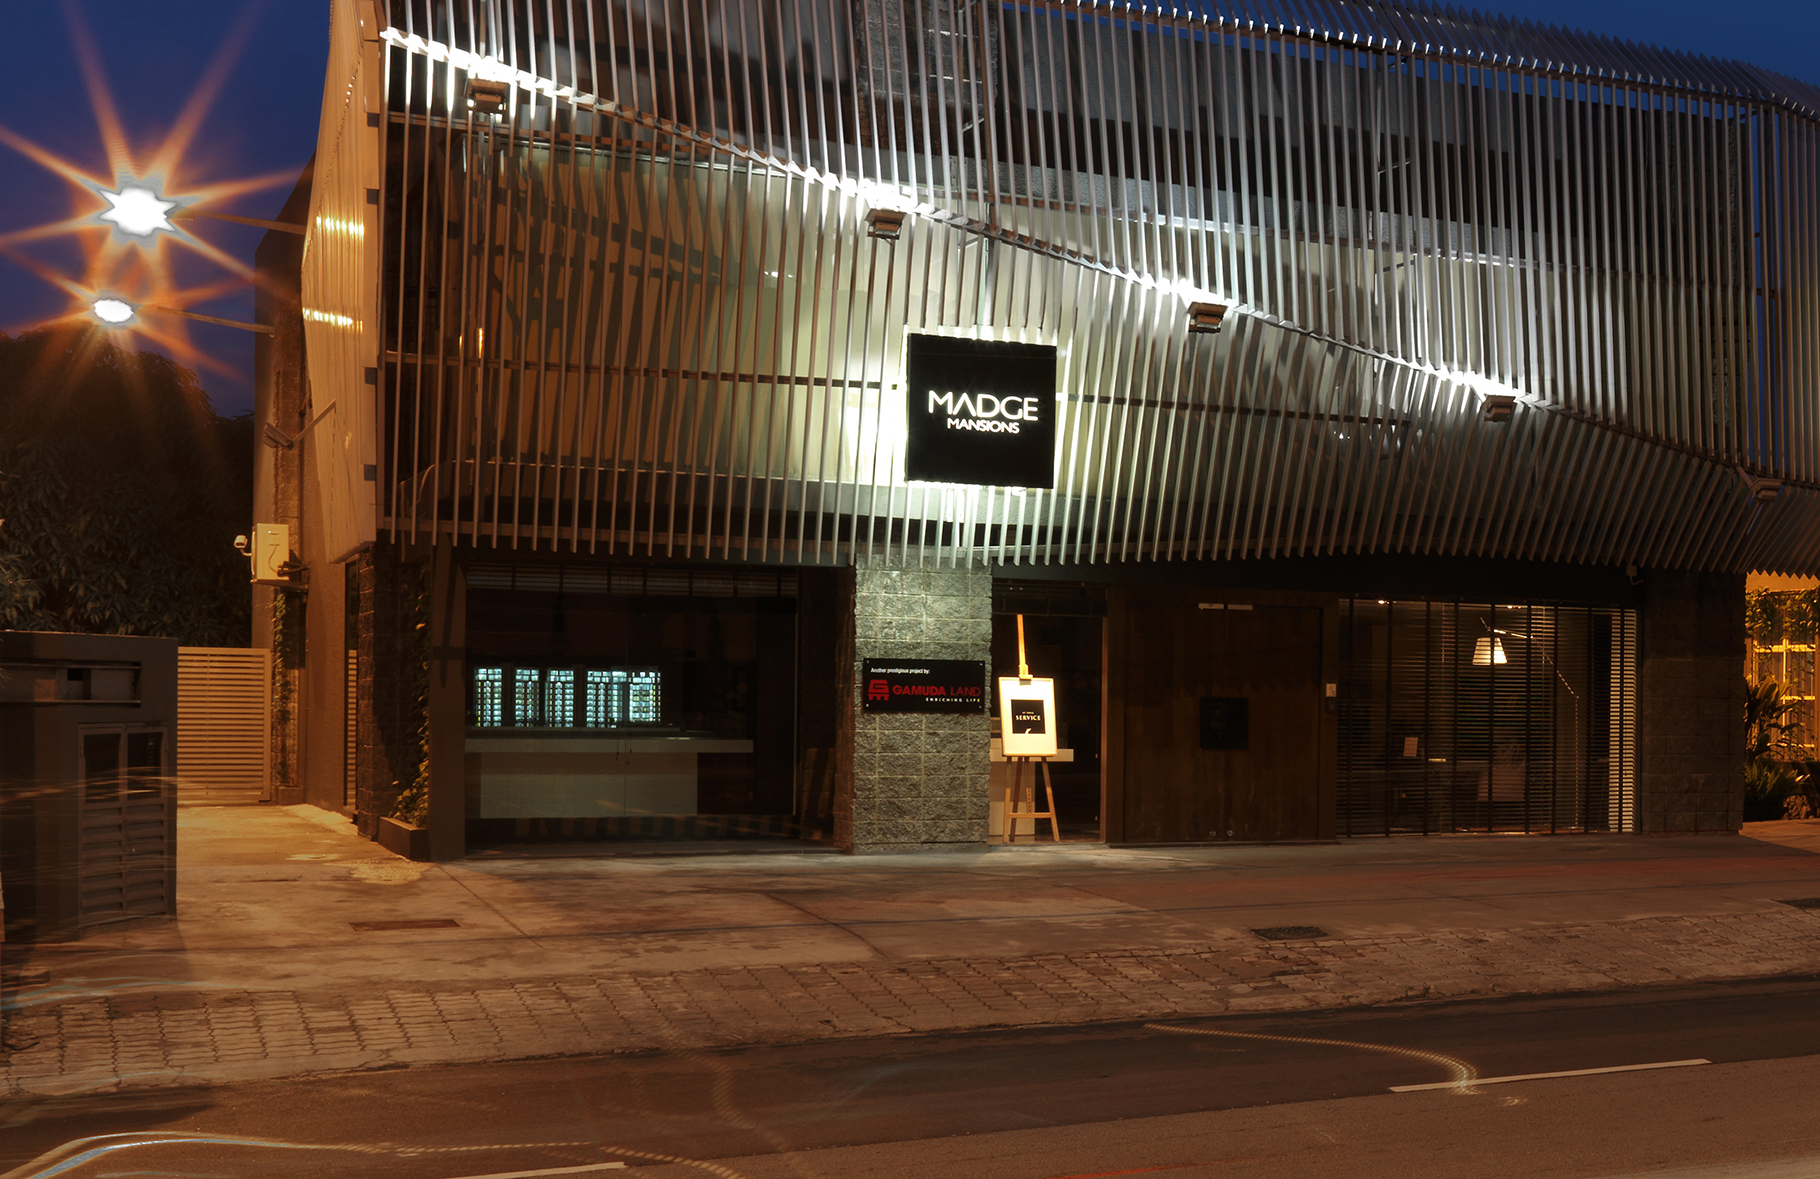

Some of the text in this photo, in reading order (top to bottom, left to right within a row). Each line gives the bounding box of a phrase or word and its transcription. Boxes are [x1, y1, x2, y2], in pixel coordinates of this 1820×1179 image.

[928, 390, 1039, 421] MADGE
[946, 417, 1020, 434] MANSIONS
[892, 684, 981, 697] GAMUDA LAND
